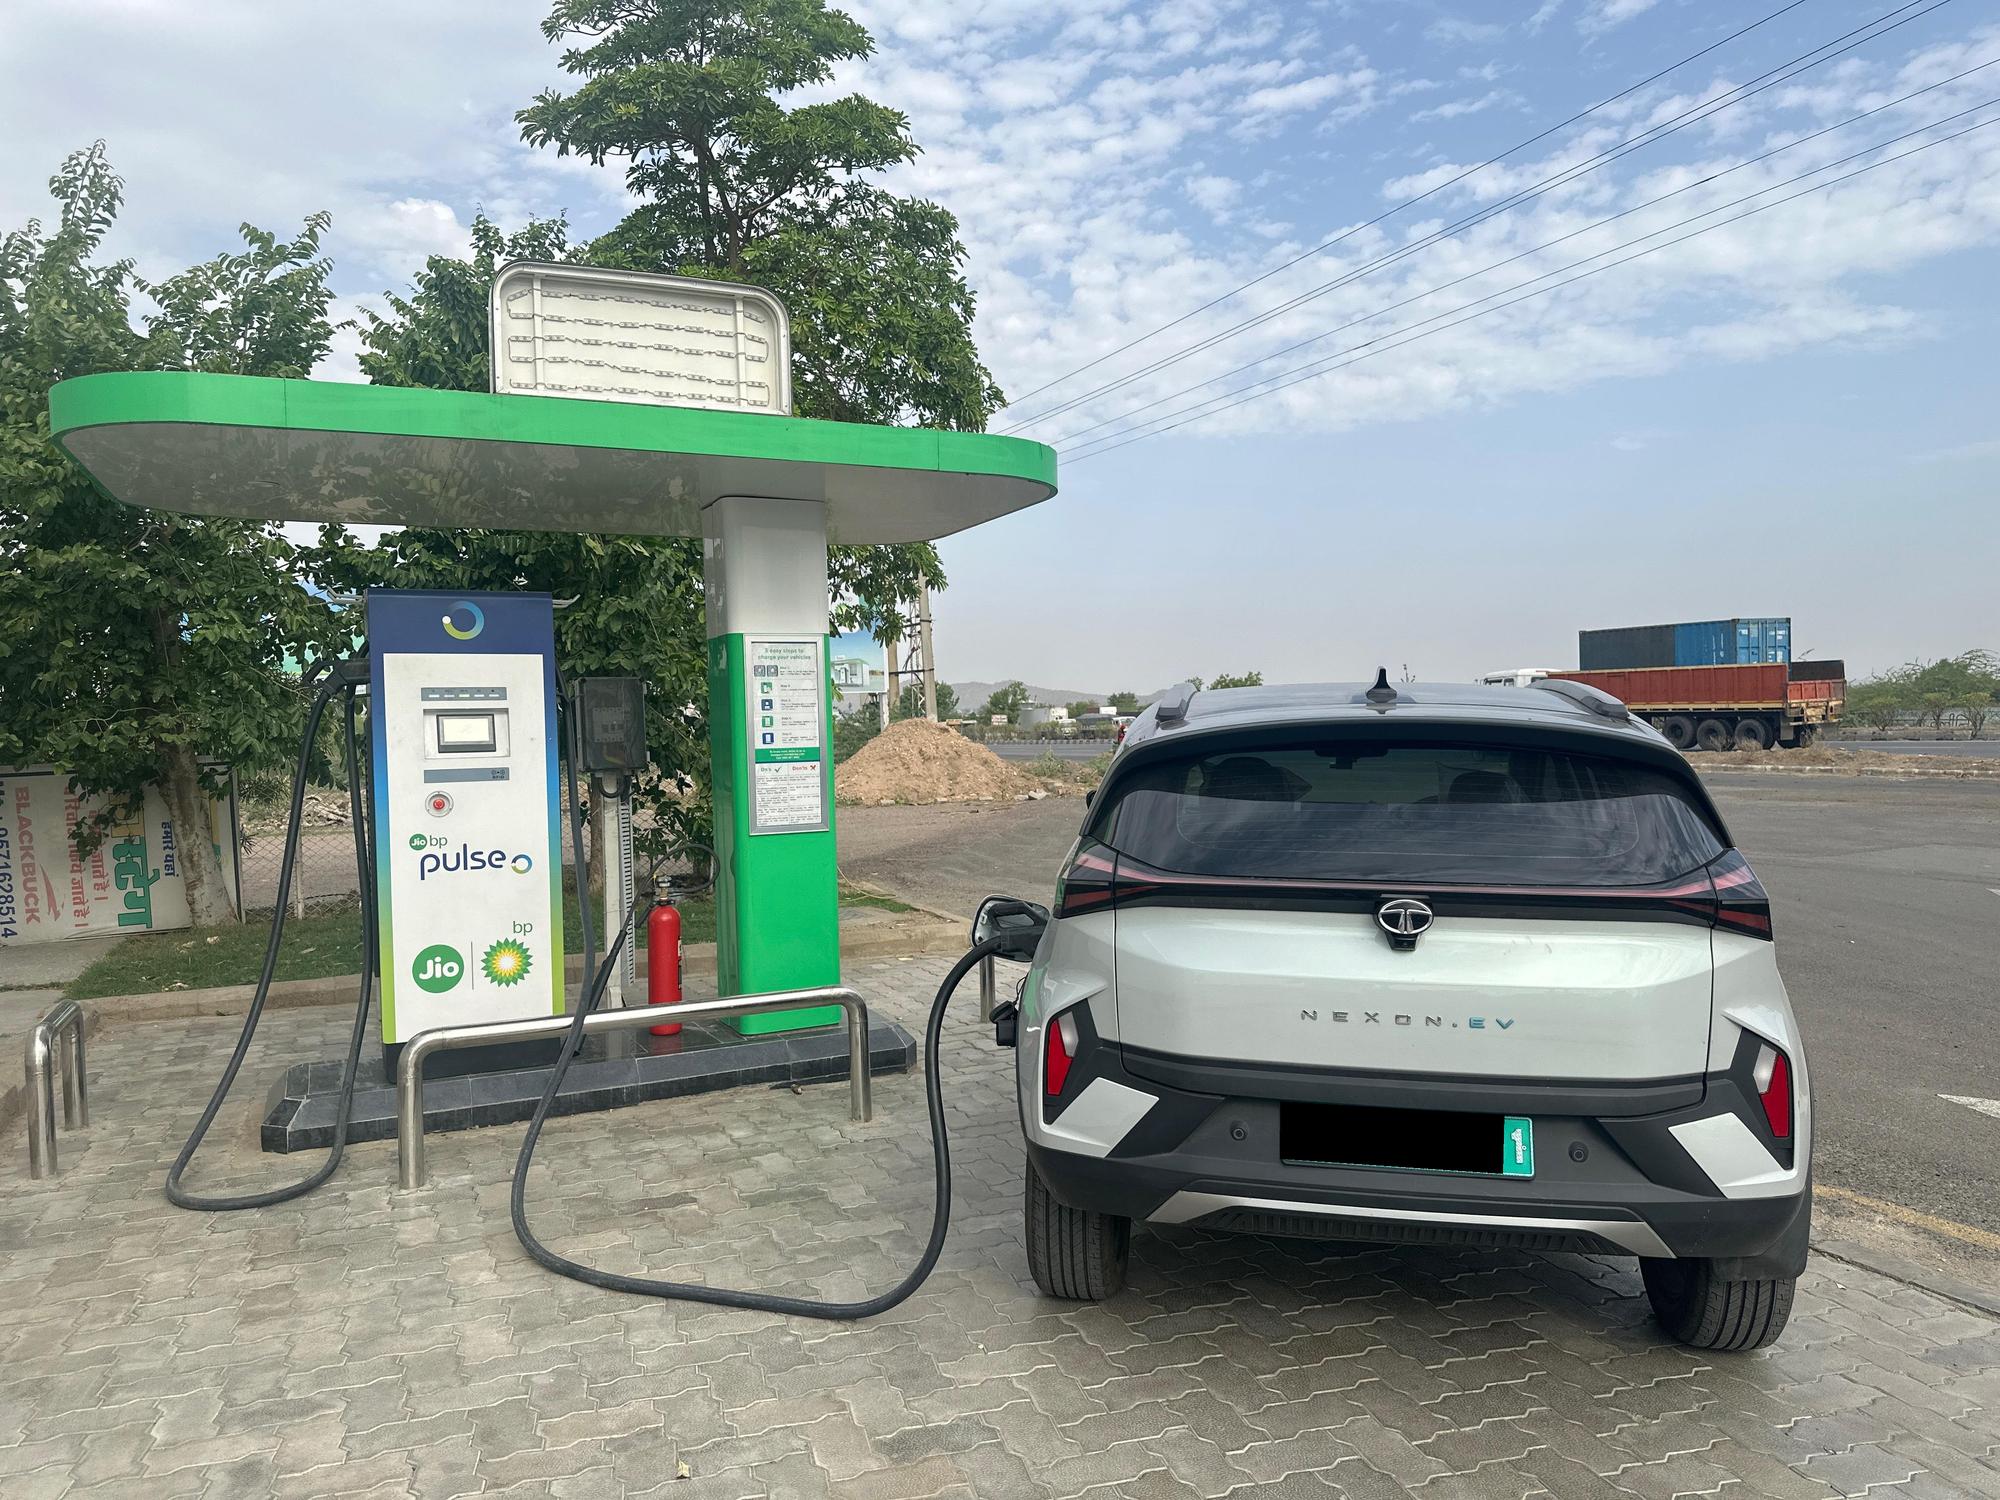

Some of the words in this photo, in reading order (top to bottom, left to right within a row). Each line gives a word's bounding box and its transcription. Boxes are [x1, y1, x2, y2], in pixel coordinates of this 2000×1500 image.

[162, 821, 176, 850] हमारे
[411, 838, 425, 846] Jio
[429, 835, 448, 849] bp
[15, 786, 41, 925] BLACKBUCK
[420, 843, 506, 880] pulse
[71, 876, 89, 906] जाते
[513, 921, 533, 936] bp
[419, 956, 459, 980] Jio
